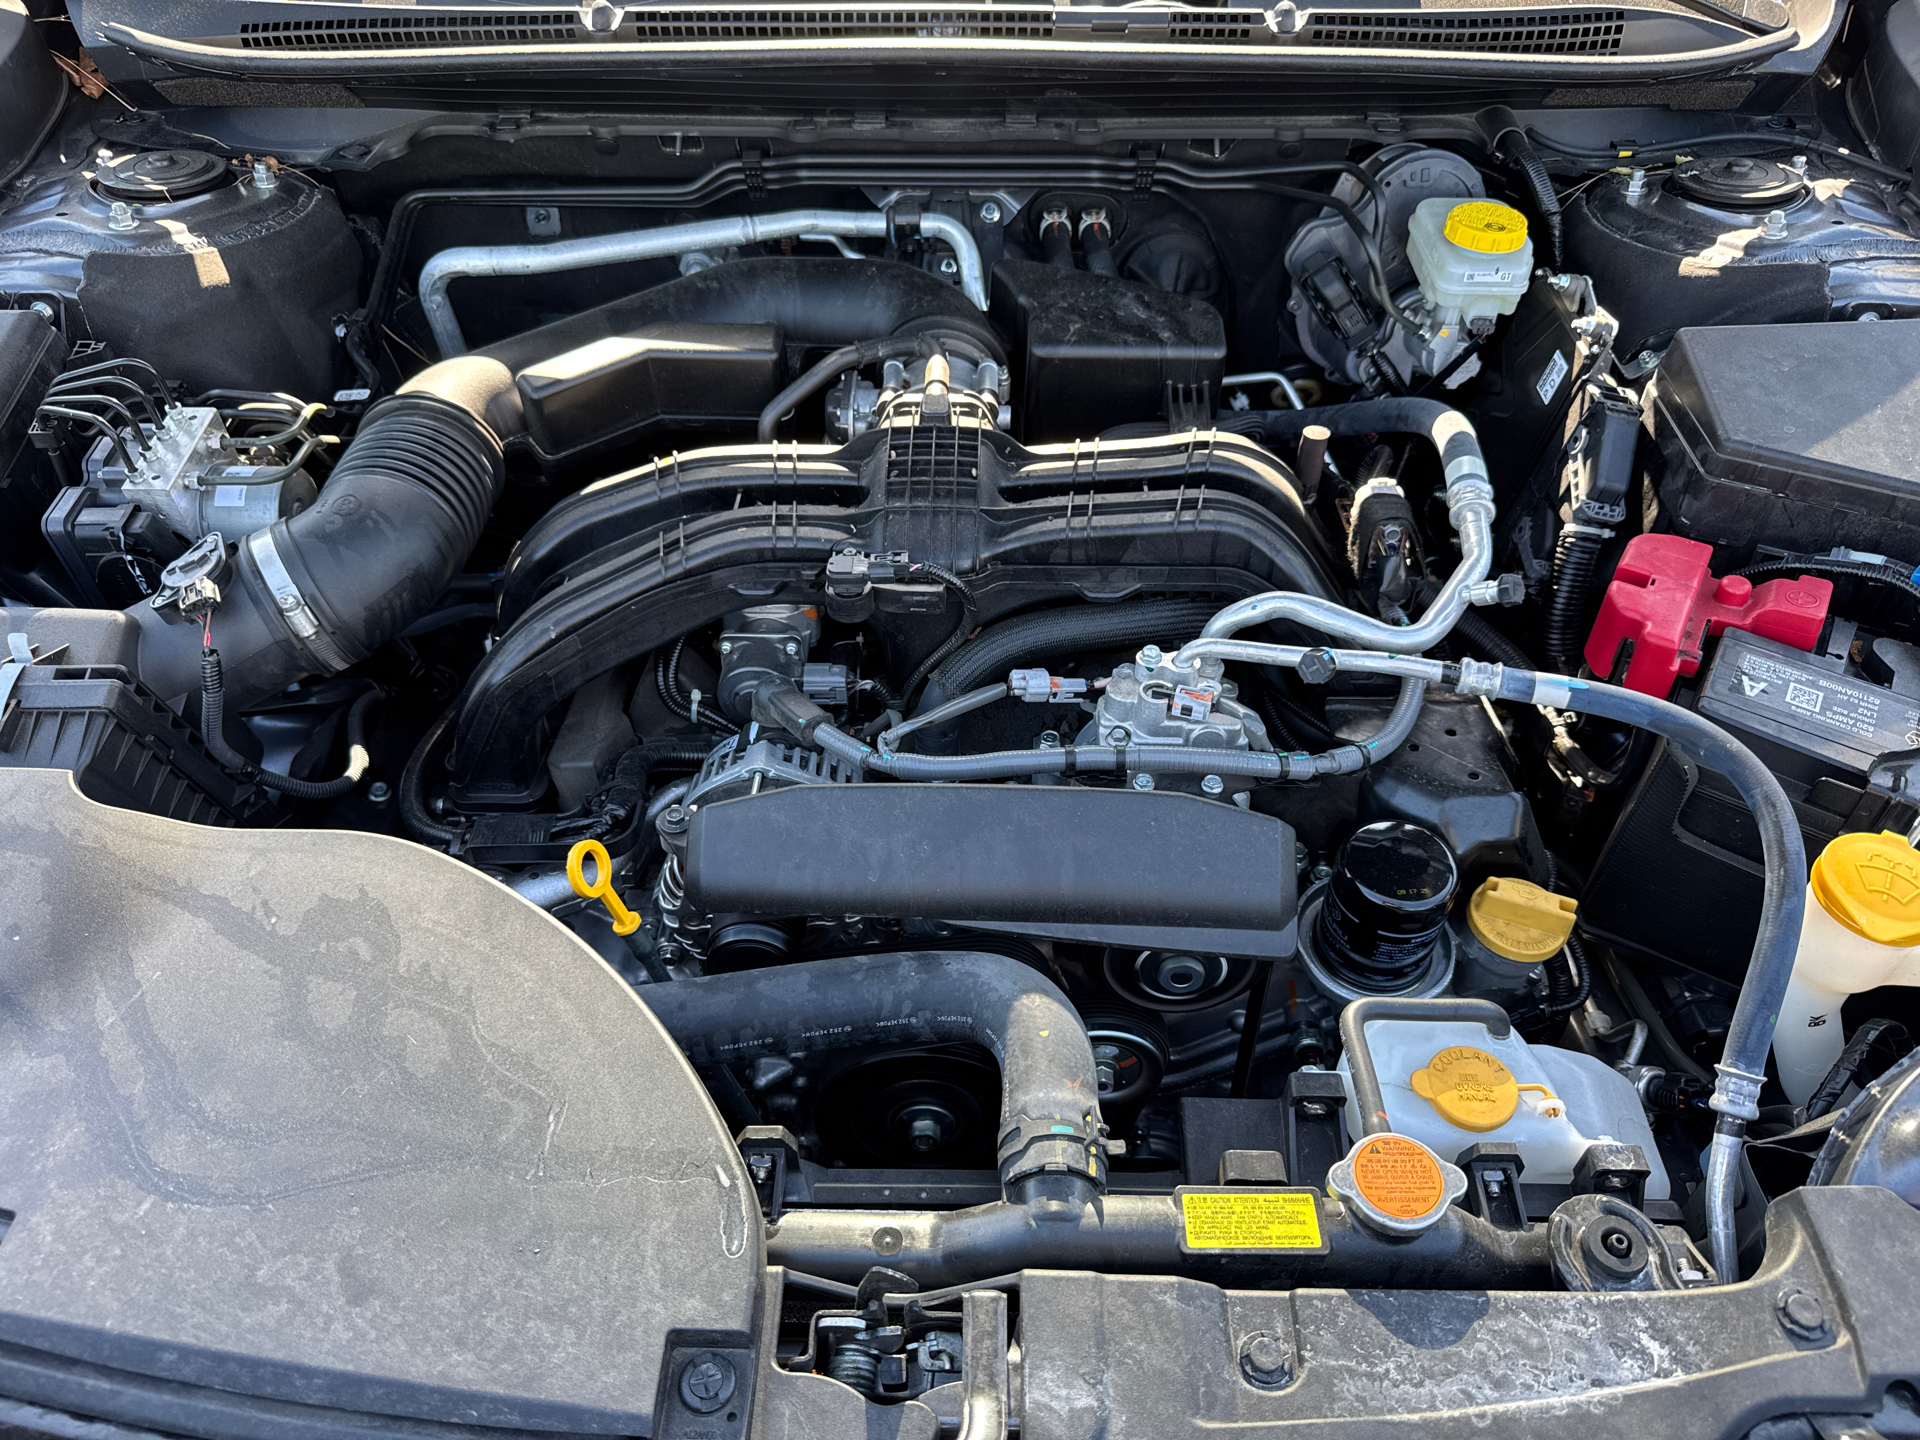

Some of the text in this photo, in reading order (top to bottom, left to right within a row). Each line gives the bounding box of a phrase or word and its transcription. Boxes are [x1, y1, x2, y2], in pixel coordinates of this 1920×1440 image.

[1500, 272, 1512, 281] GT
[1819, 679, 1880, 705] 82110AN00B
[1791, 705, 1873, 738] COLD CRANKING AMPS
[1826, 710, 1874, 732] 620 AMPS
[1832, 706, 1876, 724] GROUP SIZE
[1857, 707, 1878, 718] LN2
[1478, 918, 1491, 930] SEE
[1526, 937, 1557, 951] MANUAL
[1433, 1048, 1505, 1073] COOLANT
[1459, 1072, 1479, 1082] SEE
[1455, 1082, 1494, 1093] OWNERS
[1457, 1092, 1496, 1103] MANUAL
